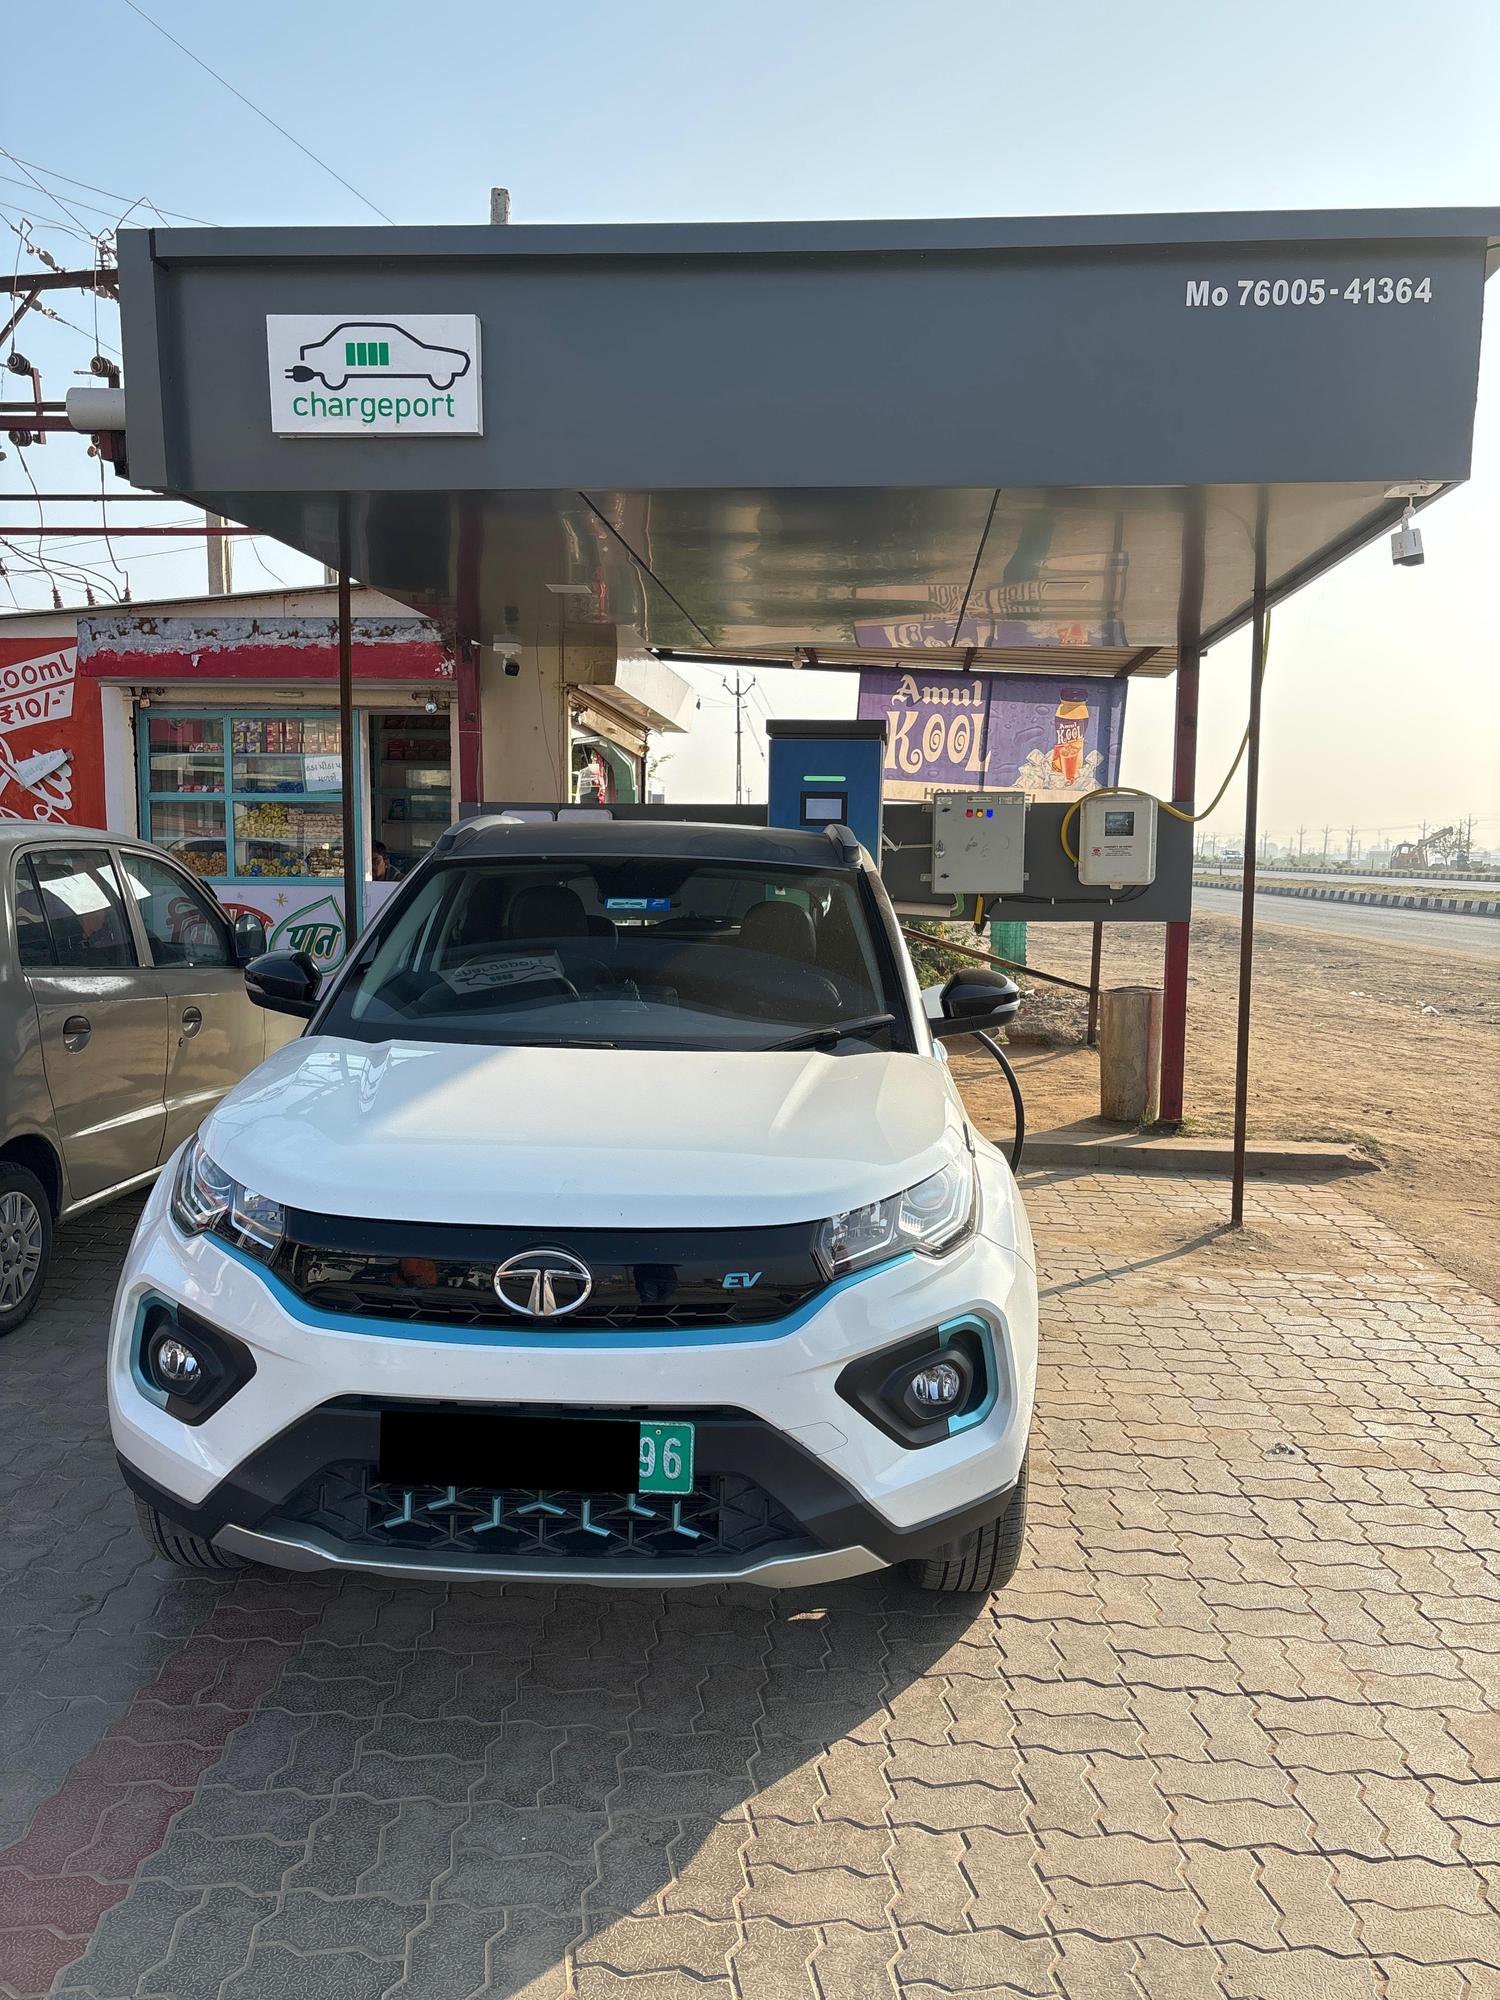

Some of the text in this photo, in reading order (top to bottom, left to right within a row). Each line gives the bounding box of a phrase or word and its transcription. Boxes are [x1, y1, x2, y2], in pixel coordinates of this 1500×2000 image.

[1186, 277, 1432, 306] Mo 76005-41364
[293, 391, 455, 424] chargeport
[891, 673, 983, 707] Amul
[884, 710, 991, 774] KOOL
[1056, 726, 1084, 744] KOOL
[722, 1271, 762, 1288] EV
